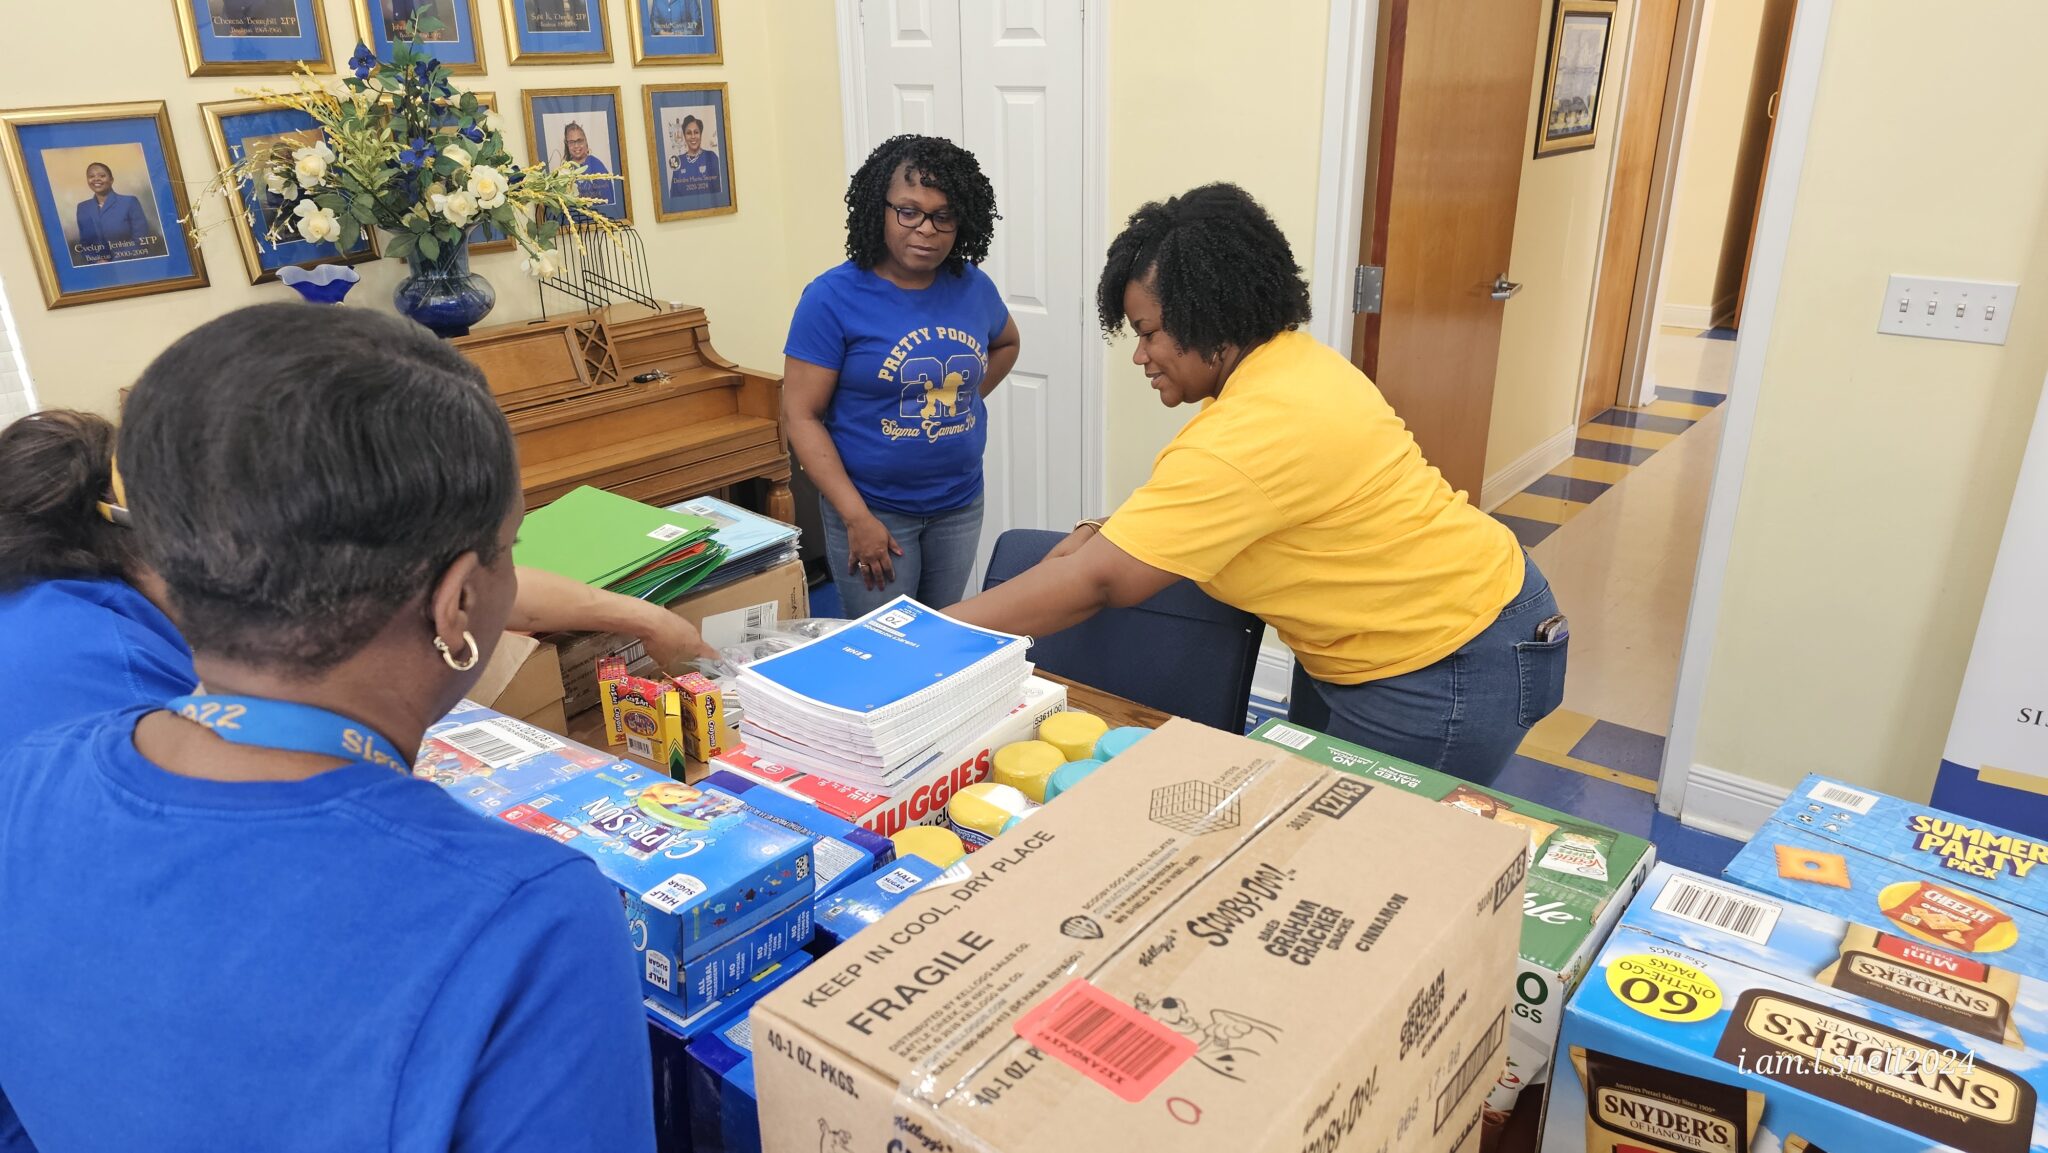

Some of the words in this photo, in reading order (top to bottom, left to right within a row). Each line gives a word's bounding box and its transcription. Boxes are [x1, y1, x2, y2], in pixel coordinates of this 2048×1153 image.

[878, 327, 931, 382] PRETTY
[881, 418, 920, 440] Sigma
[921, 419, 965, 444] Gamma
[2017, 707, 2048, 728] SI
[862, 748, 990, 837] HUGGIES
[1374, 769, 1419, 788] BAKED
[1314, 779, 1367, 815] 12743
[1913, 816, 2048, 864] SUMMER
[1919, 833, 2037, 877] PARTY
[1947, 857, 1998, 880] PACK
[668, 879, 696, 895] SUGAR
[883, 877, 905, 890] SUGAR
[894, 871, 917, 883] HALF
[650, 891, 680, 907] HALF
[801, 963, 863, 1008] KEEP
[864, 945, 894, 966] IN
[890, 904, 961, 945] COOL,
[952, 870, 995, 902] DRY
[991, 830, 1055, 873] PLACE
[1264, 899, 1322, 957] GRAHAM
[1355, 893, 1409, 952] CINNAMON
[1289, 906, 1344, 966] CRACKER
[648, 957, 668, 971] SUGAR
[1649, 958, 1697, 979] PACKS
[1903, 947, 1958, 972] Mini
[648, 971, 668, 986] HALF
[845, 930, 995, 1036] FRAGILE
[1620, 960, 1716, 1000] ON-THE-GO
[1859, 961, 1989, 1012] SNYDER'S
[1889, 965, 1947, 988] HANOVER
[1620, 977, 1698, 1016] 60
[797, 1046, 816, 1075] OZ.
[820, 1059, 859, 1099] PKGS.
[1764, 1012, 1999, 1110] SNYDER'S
[1642, 1087, 1661, 1099] Pretzel
[1662, 1092, 1682, 1105] Bakery
[1682, 1098, 1698, 1109] Since
[1876, 1083, 1913, 1102] Pretzel
[1605, 1094, 1728, 1145] SNYDER'S
[1914, 1098, 1970, 1123] America's
[1630, 1119, 1645, 1130] OF
[1648, 1124, 1702, 1147] HANOVER
